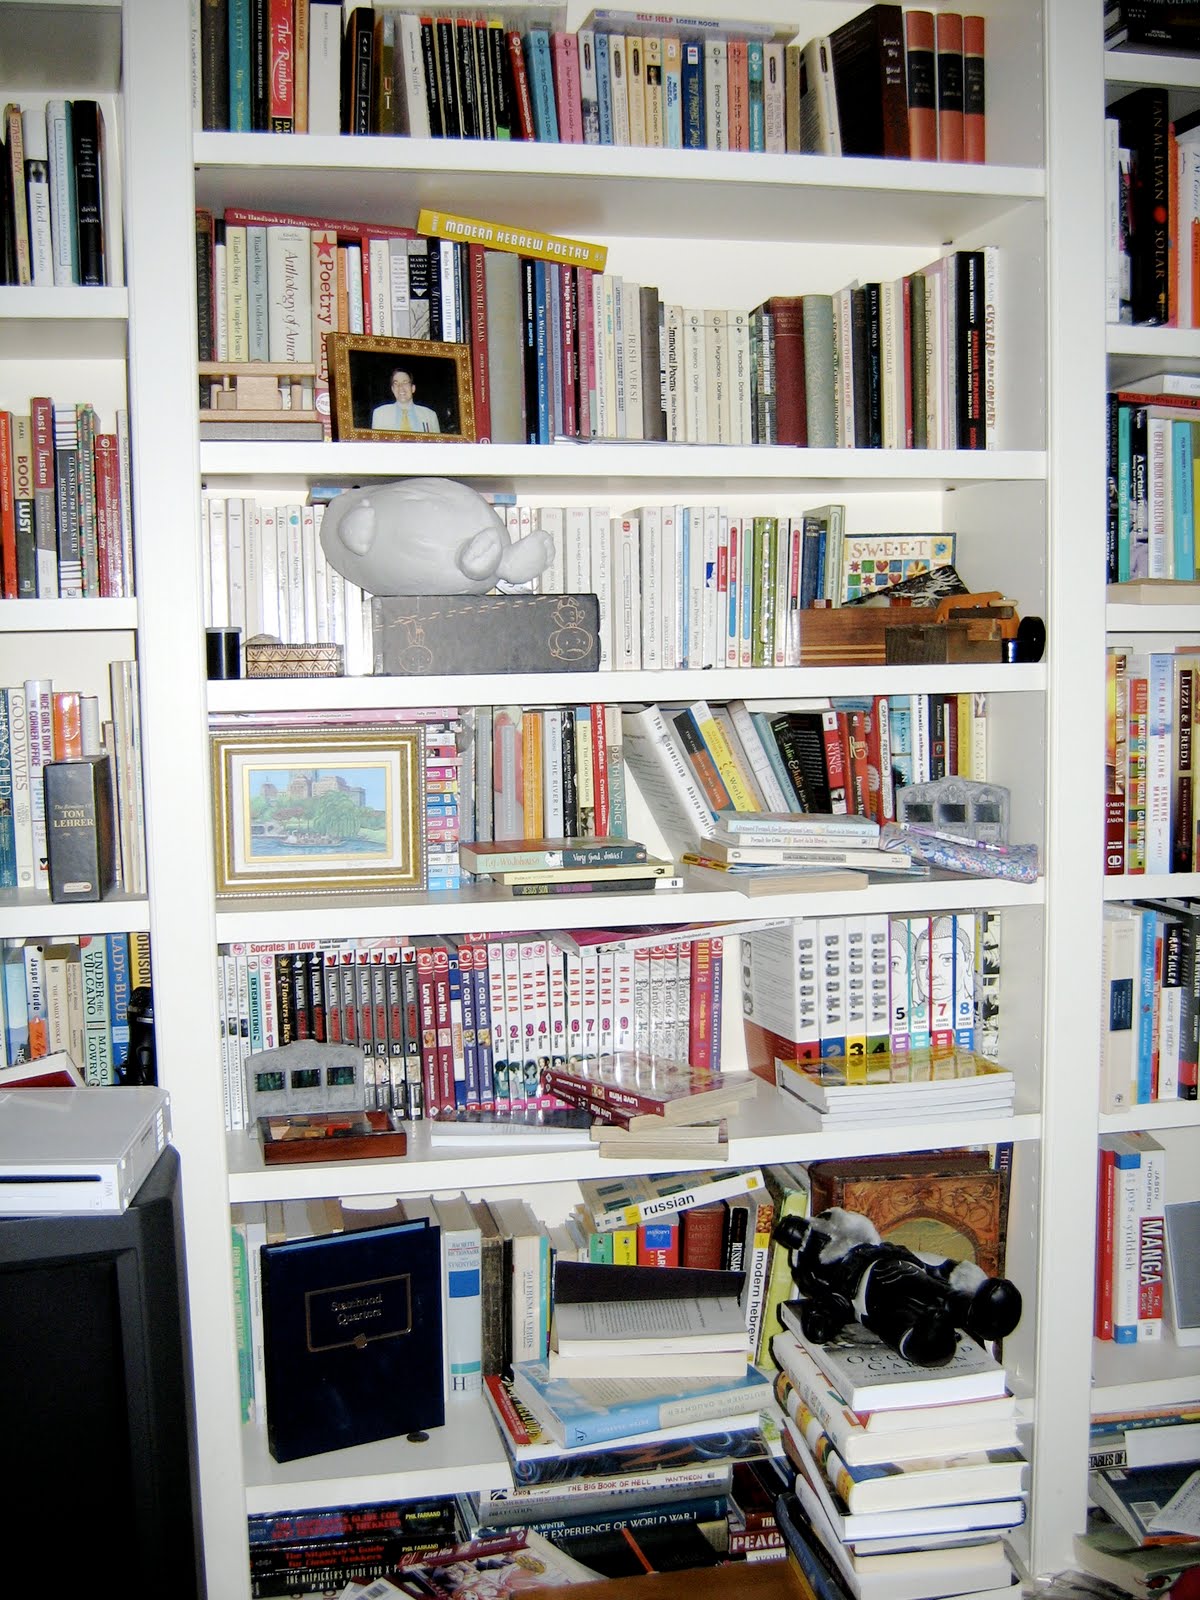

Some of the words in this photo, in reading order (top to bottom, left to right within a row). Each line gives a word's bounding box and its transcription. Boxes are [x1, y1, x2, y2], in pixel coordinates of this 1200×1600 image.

[277, 18, 289, 42] The
[272, 46, 290, 101] Rainbow
[1153, 100, 1164, 128] IAN
[12, 119, 22, 149] STASH
[13, 151, 23, 175] ENVY
[446, 220, 493, 241] MODERN
[497, 231, 543, 251] HEBREW
[547, 242, 589, 260] POETRY
[475, 254, 484, 277] POETS
[1154, 230, 1165, 279] SOLAR
[317, 260, 334, 325] Poetry
[476, 279, 484, 293] ON
[477, 312, 485, 342] PSALMS
[985, 304, 996, 355] CUSTARD
[628, 334, 637, 363] IRISH
[986, 379, 996, 430] COMPANY
[37, 407, 48, 431] Lost
[38, 435, 47, 444] in
[1154, 432, 1164, 459] OFFICIAL
[17, 456, 29, 497] BOOK
[37, 447, 50, 484] Austen
[1154, 462, 1164, 479] BOOK
[1120, 479, 1128, 504] Scripts
[1154, 482, 1164, 499] CLUB
[19, 502, 31, 534] LUST
[1155, 500, 1164, 534] SELECTION
[40, 693, 51, 710] NICE
[1180, 676, 1190, 709] LIZZI
[12, 695, 26, 740] GOOD
[30, 711, 39, 742] CORNER
[40, 712, 51, 734] GIRLS
[653, 717, 663, 731] The
[1137, 714, 1145, 744] BAKING
[1181, 714, 1190, 722] &
[31, 743, 41, 766] OFFICE
[41, 735, 52, 758] DON'T
[655, 735, 687, 778] Conversion
[783, 742, 795, 759] Julie
[827, 743, 837, 774] KING
[834, 742, 842, 772] STEPHEN
[1137, 745, 1145, 769] CAKES
[1180, 727, 1191, 766] FREDL
[15, 746, 28, 790] WIVES
[611, 746, 619, 777] DEATH
[788, 760, 800, 769] &
[613, 779, 620, 789] IN
[792, 769, 803, 788] Julia
[1138, 770, 1145, 779] IN
[1137, 781, 1145, 805] KIGALI
[62, 810, 84, 818] TOM
[614, 791, 622, 824] VENICE
[1137, 810, 1145, 829] GAILE
[54, 819, 94, 827] LEHRER
[1137, 831, 1145, 859] PARKIN
[111, 935, 124, 971] LADY
[250, 942, 286, 953] Socrates
[288, 942, 295, 951] in
[298, 940, 316, 951] Love
[30, 958, 39, 983] Jasper
[1167, 936, 1179, 984] RAT-KILLER
[84, 953, 95, 1015] VOLCANO
[117, 974, 123, 982] IN
[552, 969, 563, 1008] NANA
[570, 968, 580, 1006] NANA
[585, 968, 595, 1005] NANA
[601, 967, 612, 1005] NANA
[619, 966, 630, 1004] NANA
[849, 932, 864, 1021] BUDDHA
[32, 986, 41, 1011] Fforde
[281, 984, 290, 1018] Flowers
[422, 984, 431, 1003] Love
[438, 981, 447, 1001] Love
[491, 973, 503, 1012] NANA
[507, 973, 518, 1012] NANA
[523, 972, 534, 1011] NANA
[535, 970, 546, 1009] NANA
[635, 978, 649, 1019] Paradise
[114, 983, 127, 1021] BLUE
[895, 1007, 905, 1021] 5
[915, 1005, 925, 1017] 6
[938, 1003, 947, 1016] 7
[960, 1002, 970, 1015] 8
[283, 1024, 292, 1043] Bees
[495, 1025, 502, 1037] 1
[509, 1026, 518, 1039] 2
[526, 1024, 534, 1036] 3
[538, 1021, 546, 1033] 4
[554, 1021, 563, 1033] 5
[571, 1020, 580, 1032] 6
[586, 1019, 595, 1031] 7
[602, 1018, 611, 1031] 8
[620, 1018, 628, 1030] 9
[637, 1021, 648, 1042] Kiss
[89, 1036, 98, 1076] LOWRY
[363, 1045, 372, 1055] 11
[377, 1044, 385, 1055] 12
[392, 1044, 401, 1054] 13
[409, 1043, 417, 1054] 14
[849, 1042, 864, 1057] 3
[643, 1193, 695, 1216] russian
[1140, 1220, 1163, 1285] MANGA
[753, 1251, 764, 1300] modern
[330, 1294, 383, 1313] Statehood
[337, 1308, 382, 1326] Quarters
[748, 1302, 761, 1345] hebrew
[453, 1376, 465, 1391] H
[567, 1484, 582, 1492] THE
[583, 1483, 597, 1491] BIG
[597, 1482, 617, 1490] BOOK
[619, 1480, 629, 1488] OF
[631, 1479, 651, 1487] HELL
[665, 1474, 703, 1483] PANTHEON
[416, 1511, 441, 1519] FARRAND
[539, 1521, 565, 1529] WINTER
[551, 1524, 611, 1539] EXPERIENCE
[613, 1520, 628, 1530] OF
[630, 1515, 666, 1527] WORLD
[669, 1513, 692, 1522] WAR
